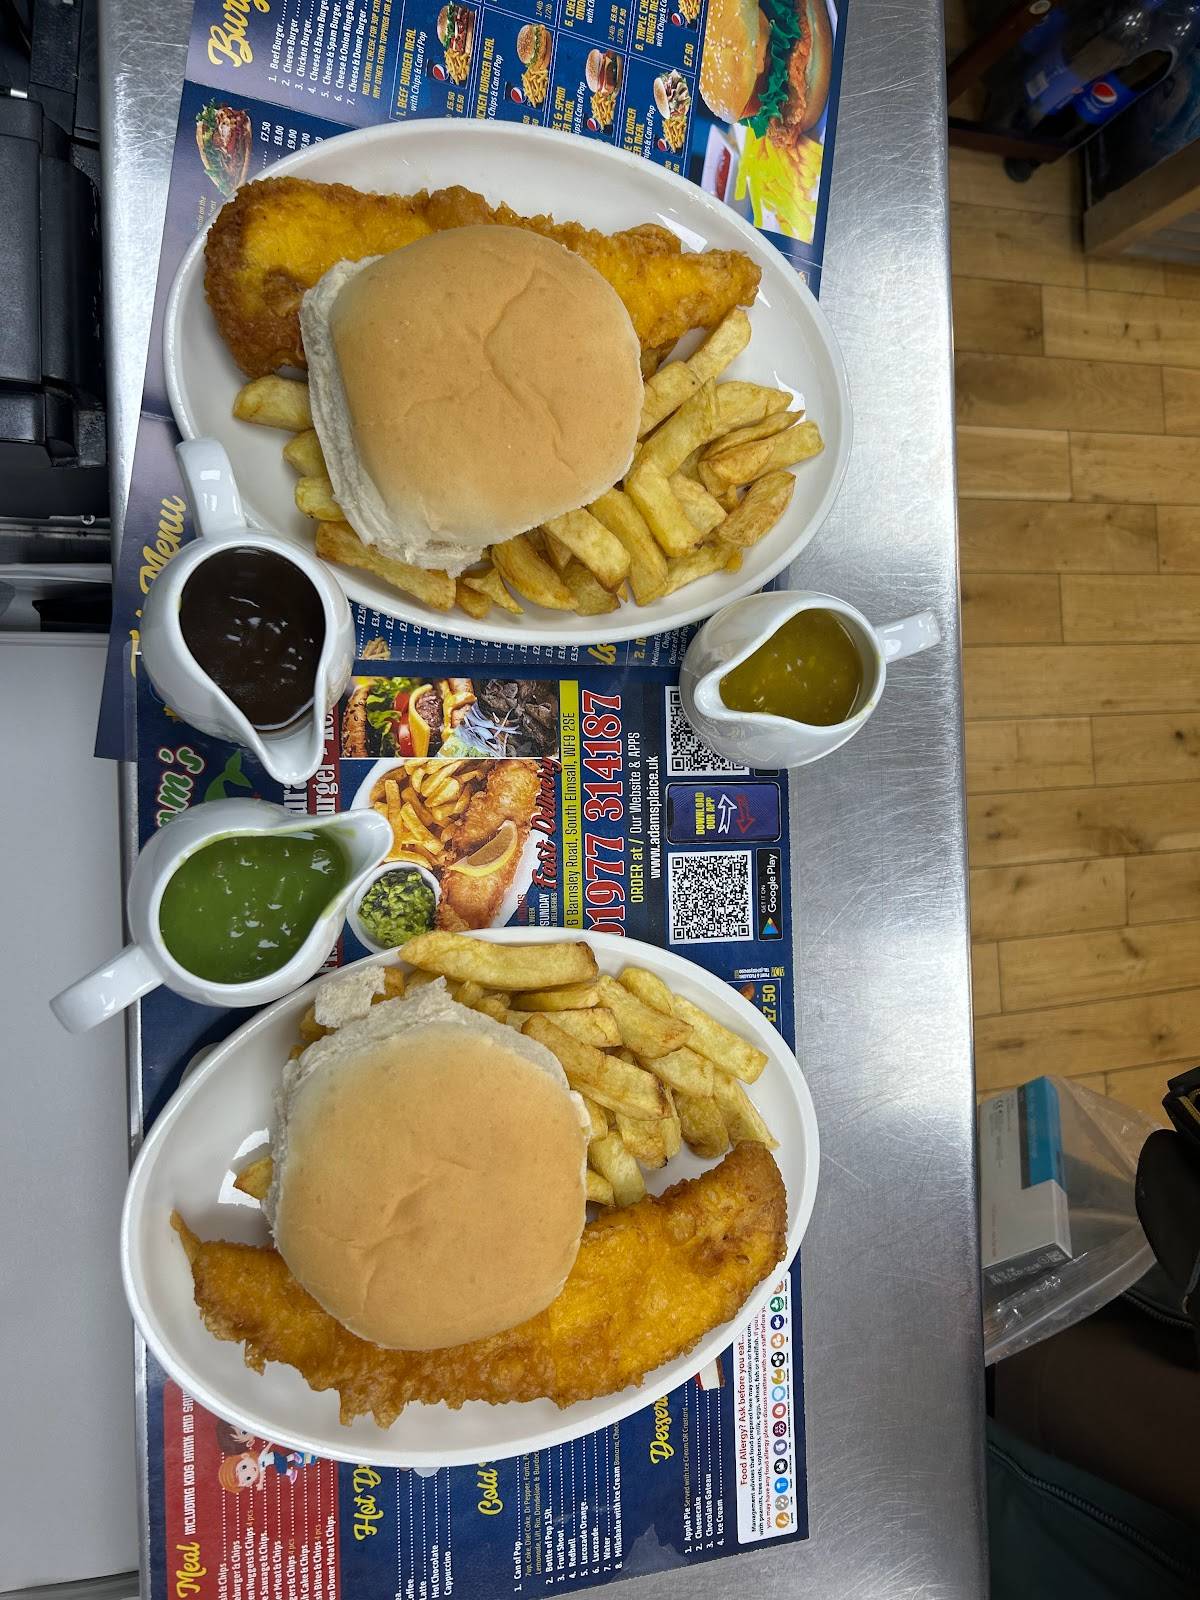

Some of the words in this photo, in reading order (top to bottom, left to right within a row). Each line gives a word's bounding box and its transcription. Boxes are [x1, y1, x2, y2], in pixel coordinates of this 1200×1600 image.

[317, 0, 329, 22] Burge
[330, 4, 343, 28] Burger
[343, 11, 354, 30] Rings
[356, 10, 368, 34] Burger
[272, 24, 285, 50] Burger
[287, 19, 299, 45] Burger
[300, 20, 313, 46] Burger
[314, 23, 325, 47] Bacon
[327, 30, 339, 51] Spam
[340, 32, 351, 54] Onion
[404, 28, 416, 51] MEAL
[418, 32, 427, 44] Pop
[353, 35, 364, 59] Doner
[483, 38, 494, 59] MEAL
[270, 50, 280, 69] Beef
[283, 46, 294, 73] Cheese
[296, 48, 308, 77] Chicken
[310, 54, 320, 80] Cheese
[323, 58, 334, 84] Cheese
[400, 53, 412, 85] BURGER
[415, 54, 423, 67] Can
[495, 55, 504, 68] Pop
[336, 62, 346, 88] Cheese
[349, 66, 359, 92] Cheese
[411, 75, 422, 94] Chips
[479, 62, 490, 93] BURGER
[491, 77, 500, 90] Can
[398, 88, 407, 108] BEEF
[410, 95, 419, 111] with
[488, 98, 498, 116] Chips
[555, 87, 565, 110] SPAM
[260, 122, 270, 142] £7.50
[274, 126, 284, 145] £8.00
[287, 129, 297, 149] £9.00
[635, 124, 644, 144] MEAL
[139, 496, 186, 594] Menu
[562, 712, 575, 731] 2SE
[563, 735, 576, 757] WF9
[582, 690, 624, 821] 314187
[627, 732, 640, 757] APPS
[312, 764, 338, 816] urger
[564, 761, 577, 800] Elmsall,
[628, 772, 642, 813] Website
[530, 756, 562, 835] Delivery
[705, 797, 715, 812] APP
[564, 805, 577, 834] South
[630, 816, 641, 833] Our
[646, 756, 662, 879] www.adamsplaice.uk
[695, 792, 705, 835] DOWNLOAD
[706, 814, 715, 829] OUR
[532, 840, 558, 889] Fast
[566, 839, 578, 866] Road,
[630, 847, 642, 860] at
[767, 854, 777, 874] Play
[566, 871, 580, 915] Barnsley
[630, 864, 644, 903] ORDER
[768, 876, 778, 913] Google
[539, 893, 550, 925] SUNDAY
[738, 1376, 746, 1404] before
[182, 1414, 194, 1433] AND
[738, 1406, 746, 1422] Ask
[183, 1435, 195, 1463] DRINK
[739, 1425, 748, 1460] Allergy?
[184, 1464, 196, 1486] KIDS
[613, 1466, 621, 1490] Cream
[477, 1469, 503, 1515] Cold
[613, 1490, 621, 1501] Ice
[184, 1487, 196, 1535] INCLUDING
[353, 1494, 384, 1541] Hot
[580, 1502, 589, 1529] Orange
[613, 1502, 621, 1519] with
[694, 1496, 702, 1539] Cheesecake
[326, 1515, 336, 1537] Chips
[546, 1526, 554, 1540] Pop
[259, 1532, 269, 1554] Chips
[514, 1541, 523, 1555] Pop
[580, 1530, 588, 1564] Lucozade
[591, 1528, 599, 1562] Lucozade
[603, 1537, 611, 1560] Water
[614, 1520, 622, 1557] Milkshake
[299, 1545, 310, 1566] Chips
[313, 1541, 324, 1563] Chips
[327, 1544, 335, 1564] Meat
[430, 1545, 439, 1582] Chocolate
[545, 1550, 553, 1572] Bottle
[568, 1538, 576, 1566] Redbull
[176, 1542, 207, 1598] Meal
[260, 1562, 270, 1594] Sausage
[314, 1570, 323, 1590] Bites
[327, 1566, 336, 1590] Doner
[443, 1551, 454, 1595] Cappuccino
[514, 1564, 522, 1579] Can
[300, 1573, 309, 1593] Cake
[432, 1583, 440, 1598] Hot
